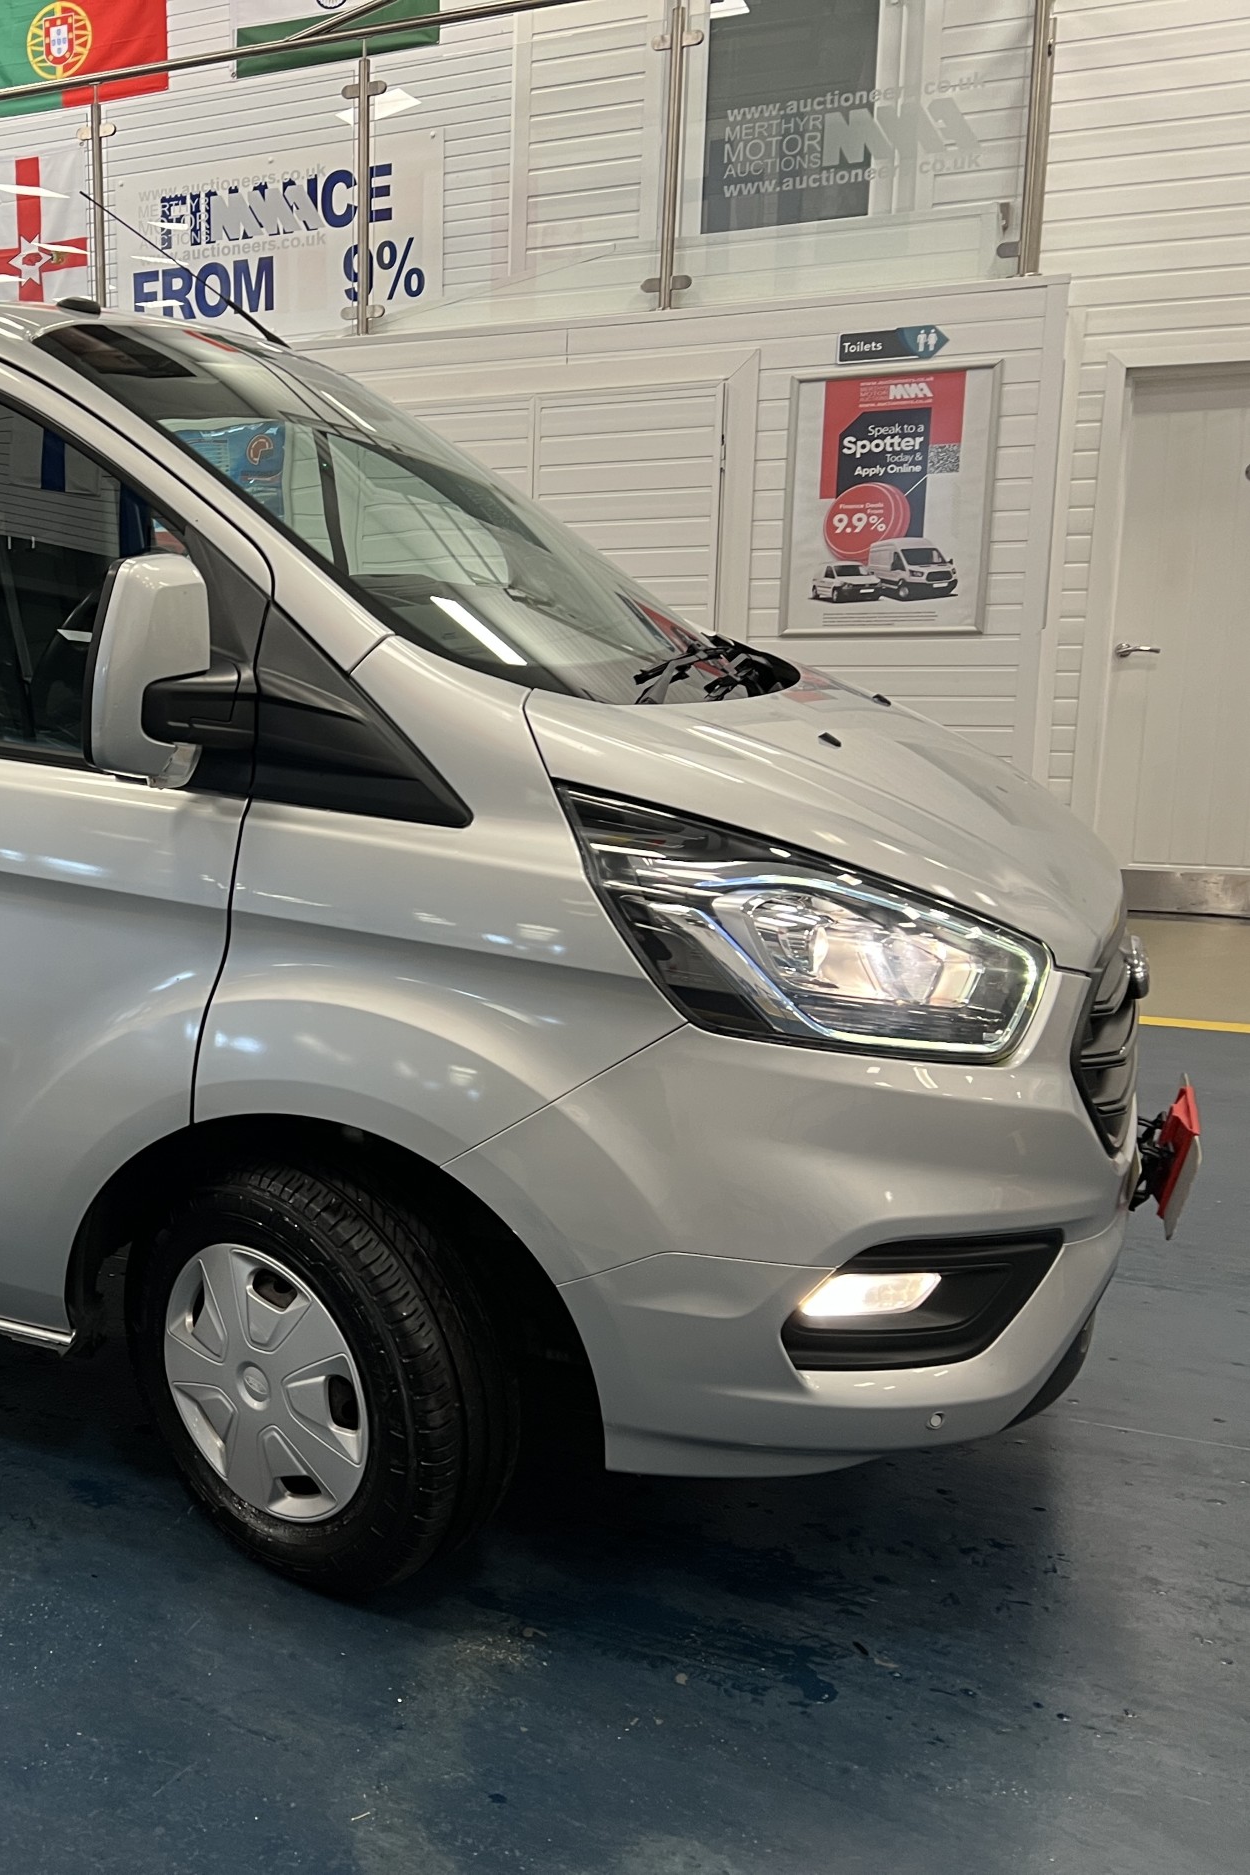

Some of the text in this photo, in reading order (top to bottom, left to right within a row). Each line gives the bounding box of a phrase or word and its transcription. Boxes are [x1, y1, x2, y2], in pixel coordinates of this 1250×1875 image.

[725, 115, 822, 141] MERTHYR
[723, 132, 821, 164] MOTOR
[723, 153, 821, 179] AUCTIONS
[133, 256, 274, 320] FROM
[842, 341, 883, 353] Toilets
[868, 423, 925, 437] Speak to a
[842, 435, 924, 458] Spotter
[885, 452, 923, 465] Today &
[854, 464, 922, 477] Apply Online
[832, 512, 886, 534] 9.9%
